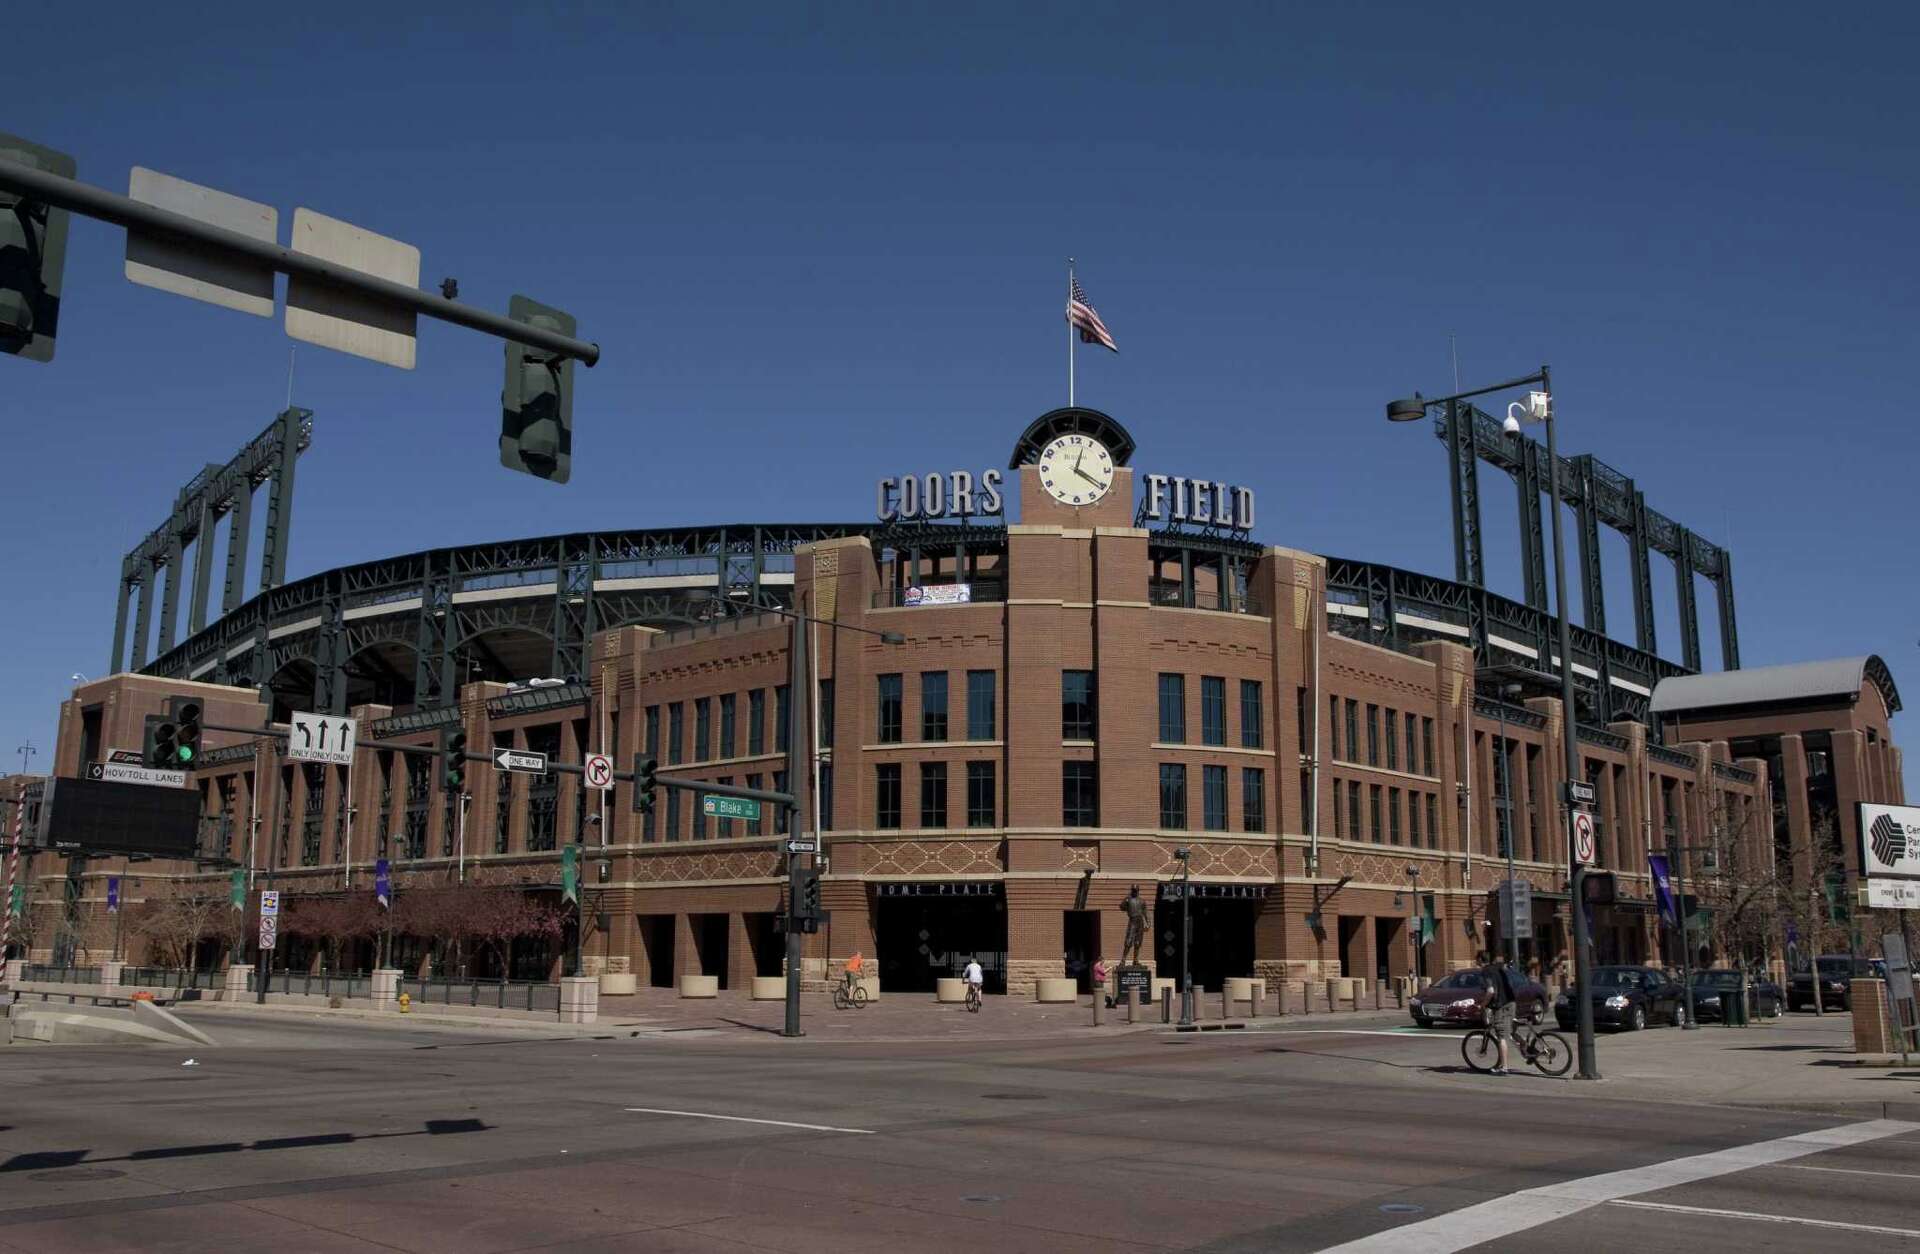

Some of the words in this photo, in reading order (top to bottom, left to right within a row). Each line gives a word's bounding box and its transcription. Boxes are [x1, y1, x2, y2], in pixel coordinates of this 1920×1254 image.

[1055, 440, 1065, 448] 11
[1044, 448, 1055, 459] 10
[1098, 452, 1107, 460] 2
[1041, 465, 1049, 473] 9
[877, 469, 1002, 520] COORS
[1145, 474, 1255, 529] FIELD
[1088, 491, 1096, 500] 5
[291, 748, 310, 757] ONLY
[312, 750, 330, 759] ONLY
[333, 753, 350, 761] ONLY
[509, 757, 523, 766] ONE
[526, 758, 540, 768] WAY
[105, 768, 150, 781] HOV/TOLL
[155, 774, 184, 785] LANES
[720, 801, 742, 814] Blake
